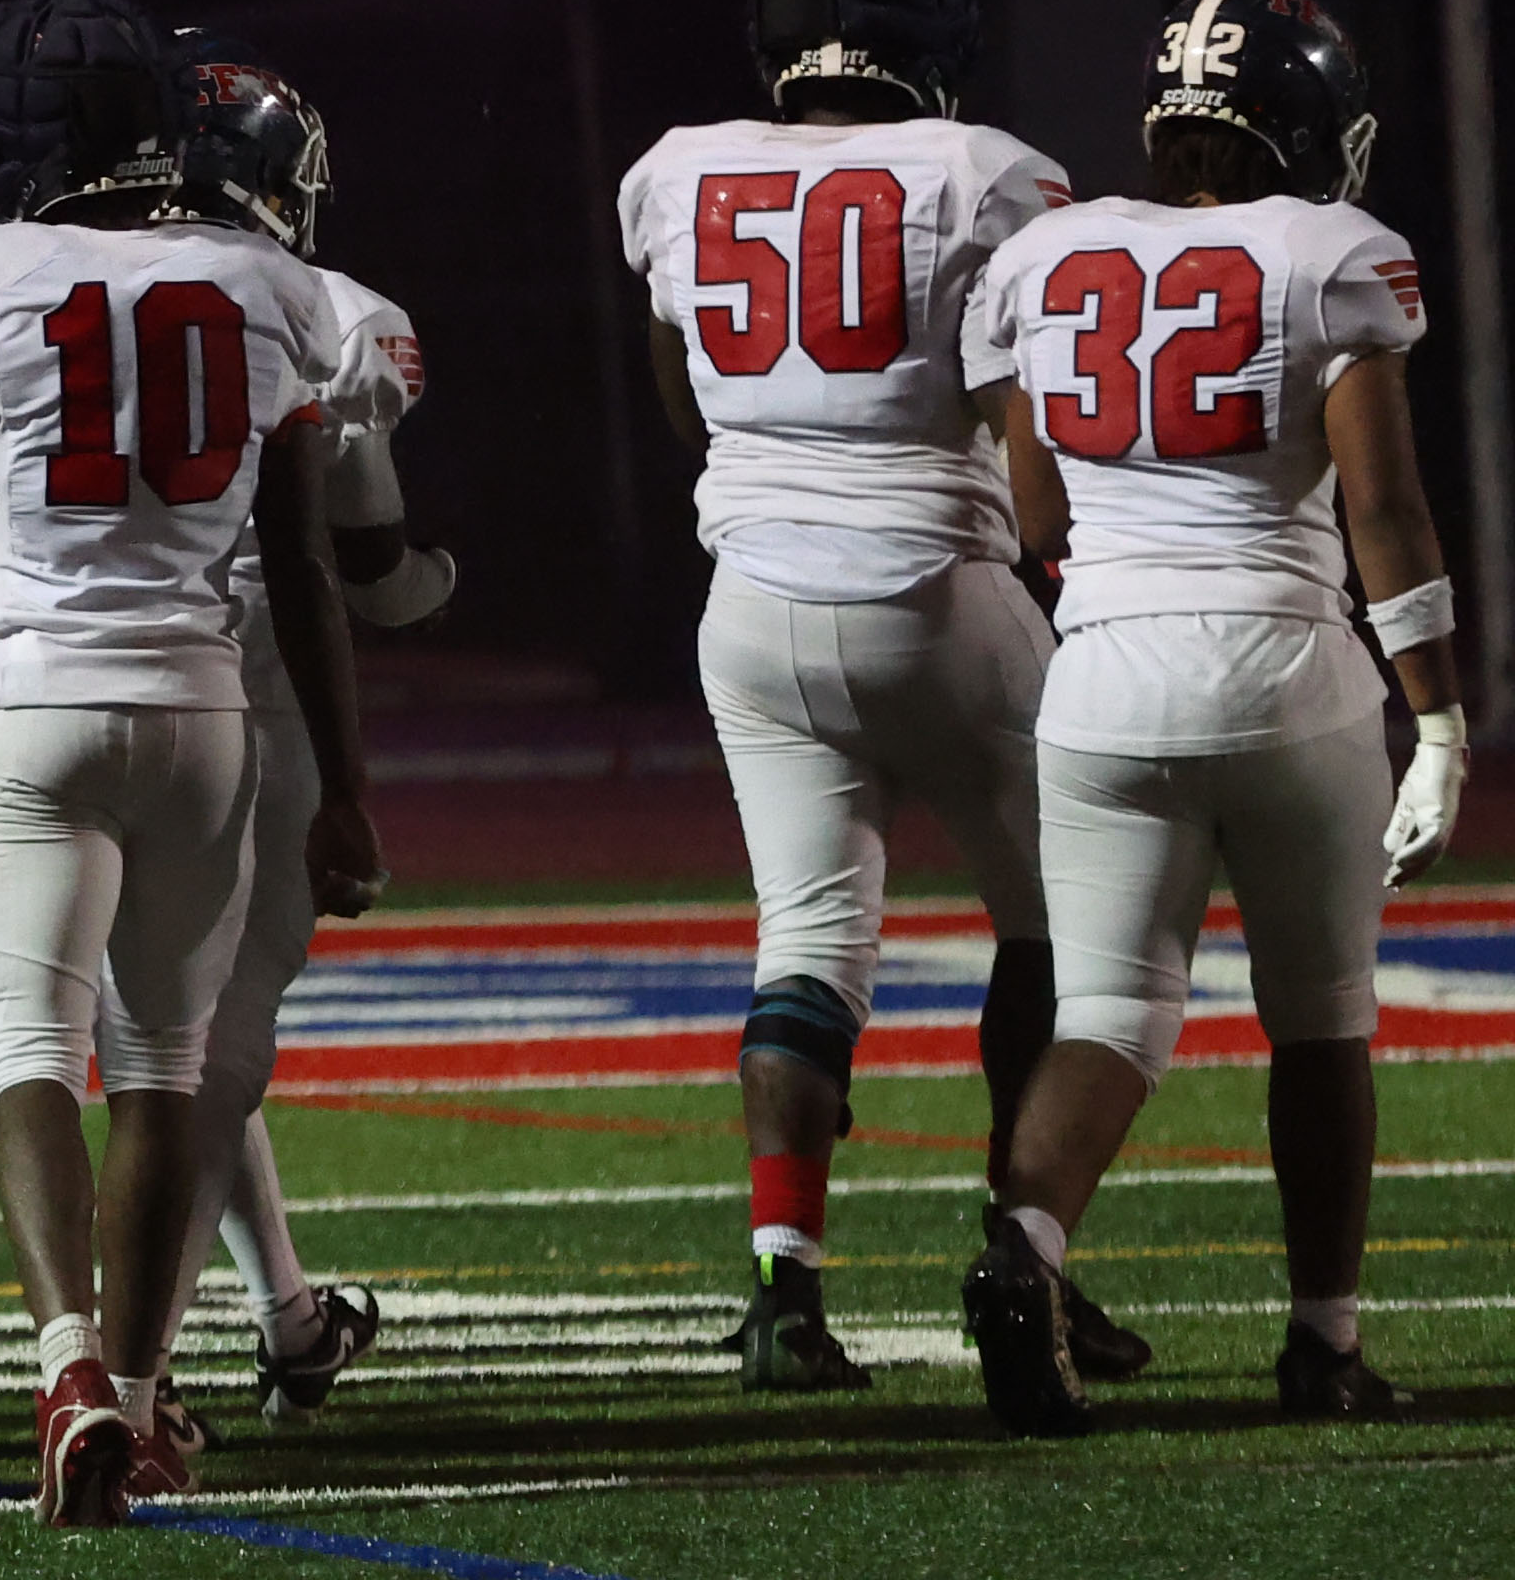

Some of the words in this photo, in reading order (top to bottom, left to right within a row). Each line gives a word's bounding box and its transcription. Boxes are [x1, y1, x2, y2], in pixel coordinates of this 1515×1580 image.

[1157, 20, 1246, 78] 32
[1160, 84, 1226, 107] schutt
[695, 168, 909, 376] 50
[1042, 246, 1268, 460] 32
[43, 280, 251, 506] 10
